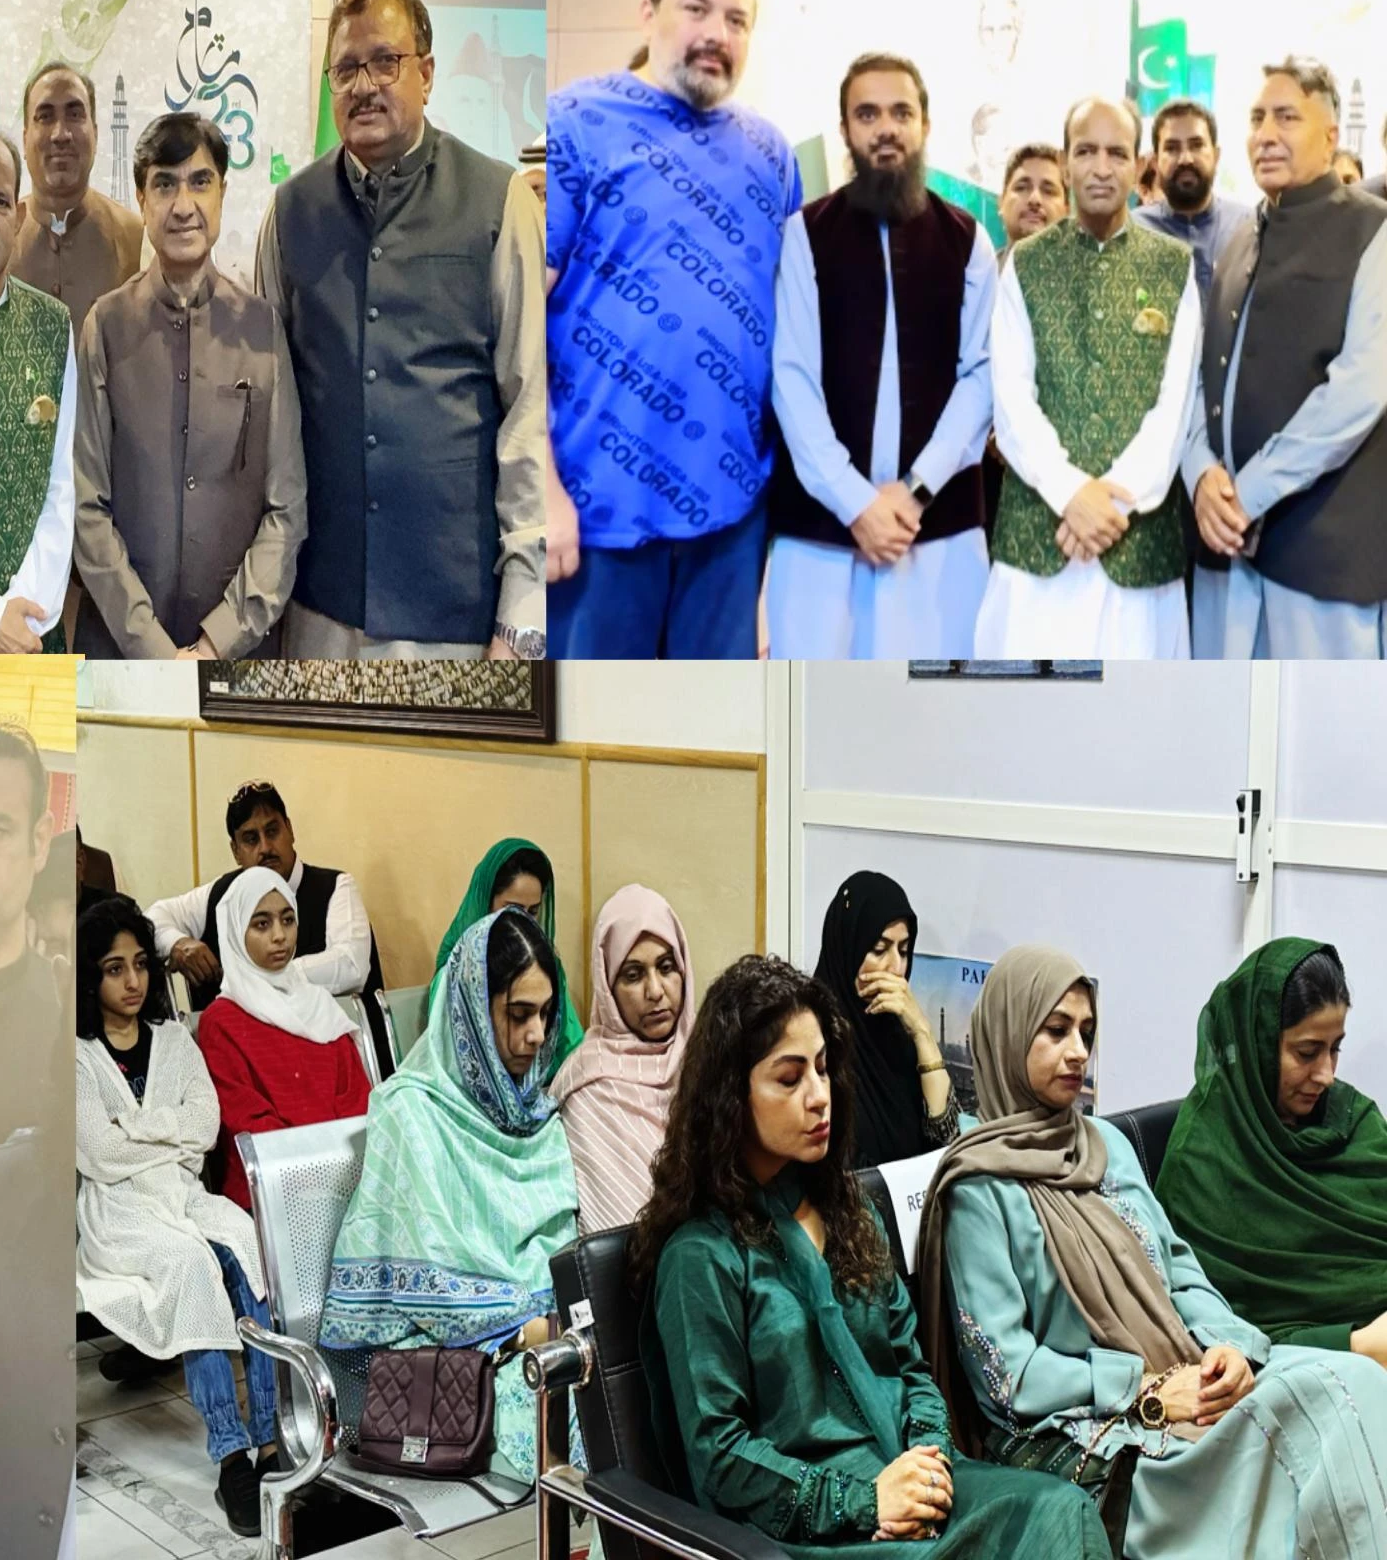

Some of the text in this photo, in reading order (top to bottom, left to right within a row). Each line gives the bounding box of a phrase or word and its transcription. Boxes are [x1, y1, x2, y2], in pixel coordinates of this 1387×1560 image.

[630, 141, 745, 246] COLORADO
[666, 241, 767, 348] COLORADO
[572, 325, 686, 425] COLORADO
[599, 431, 709, 527] COLORADO
